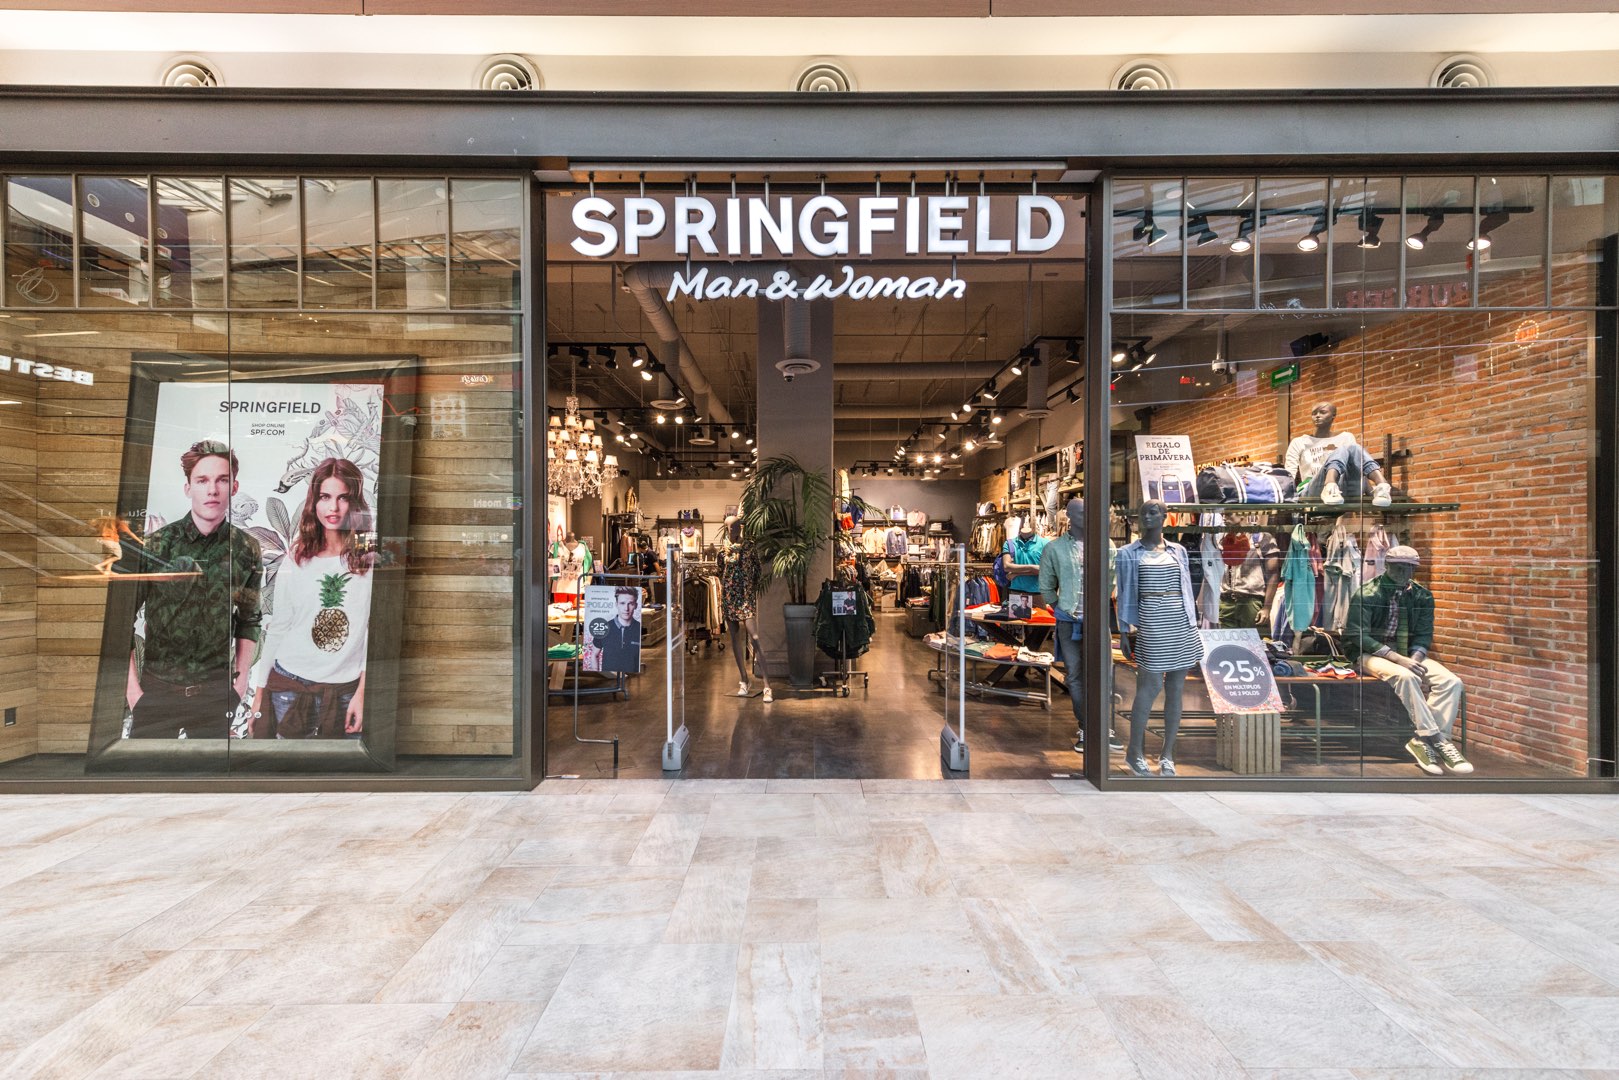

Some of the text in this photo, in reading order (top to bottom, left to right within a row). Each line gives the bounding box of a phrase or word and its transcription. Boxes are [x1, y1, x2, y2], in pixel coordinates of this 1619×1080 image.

[570, 195, 1066, 257] SPRINGFIELD
[219, 401, 321, 413] SPRINGFIELD
[1203, 630, 1250, 641] POLOS
[1212, 660, 1265, 682] -25%
